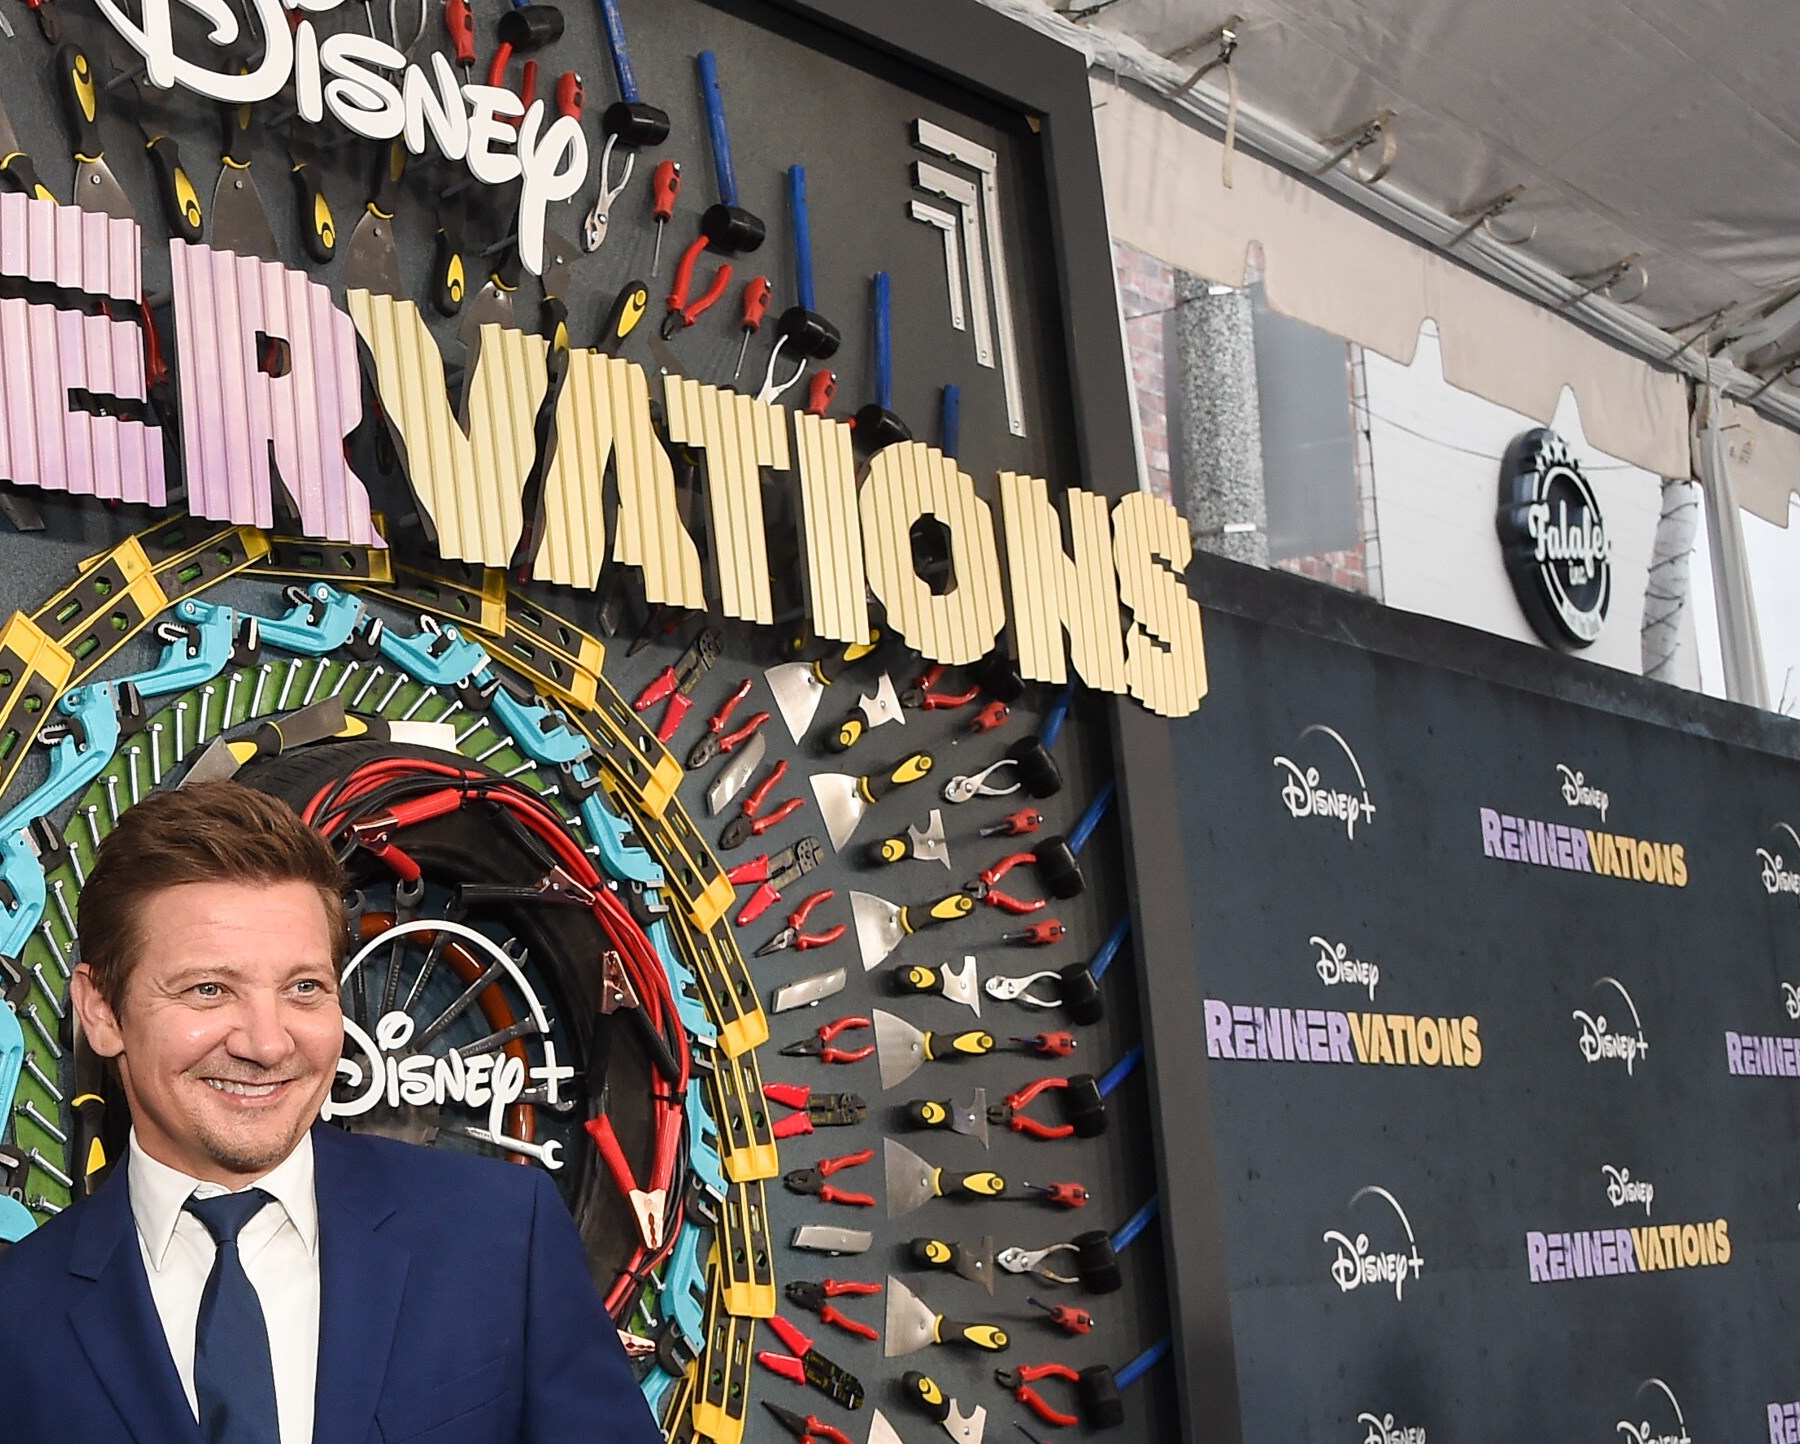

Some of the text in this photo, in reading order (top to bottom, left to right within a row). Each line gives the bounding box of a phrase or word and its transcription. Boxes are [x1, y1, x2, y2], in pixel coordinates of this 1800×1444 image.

[1556, 763, 1609, 824] Disney
[1480, 807, 1688, 888] RENNERVATIONS
[1309, 935, 1380, 1002] Disney
[1204, 999, 1482, 1067] RENNERVATIONS
[1602, 1164, 1654, 1217] Disney
[1526, 1218, 1732, 1283] RENNERVATIONS
